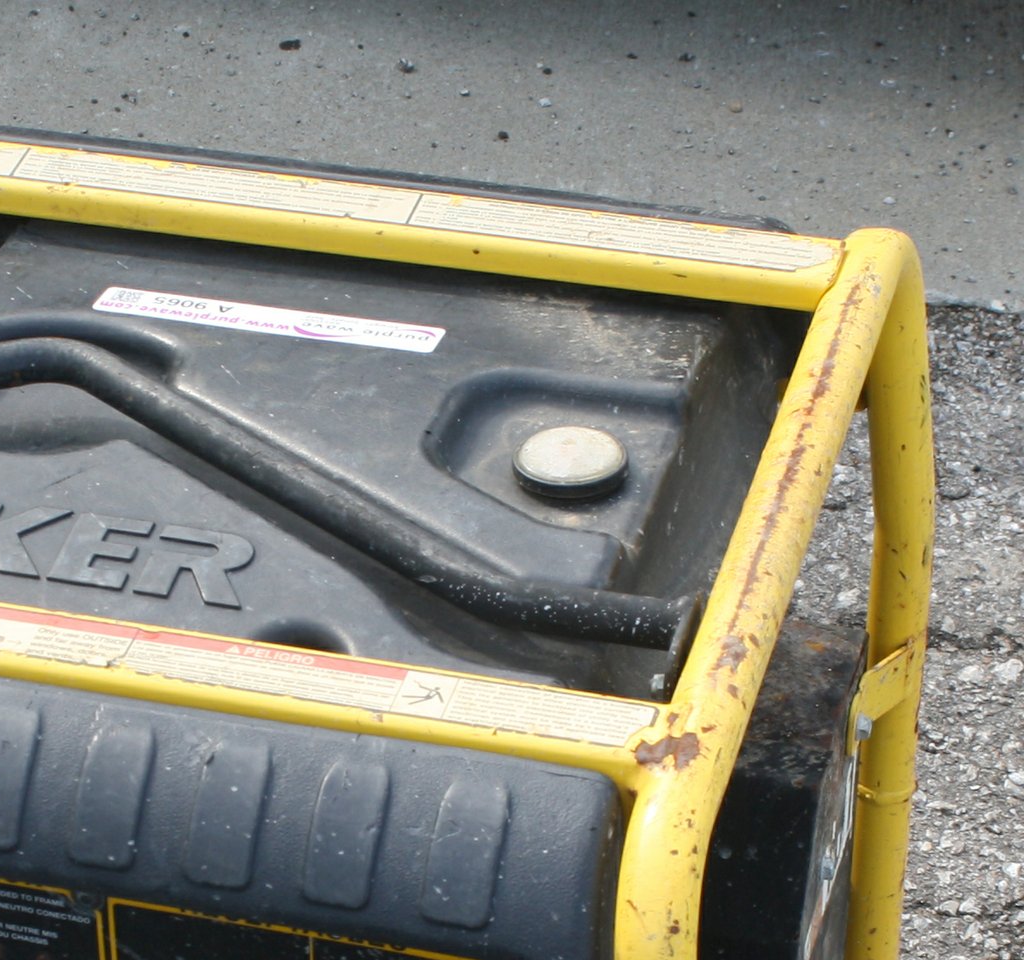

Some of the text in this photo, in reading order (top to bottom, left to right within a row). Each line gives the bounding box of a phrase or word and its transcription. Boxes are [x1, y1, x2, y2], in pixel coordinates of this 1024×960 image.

[154, 296, 233, 314] A 9065
[100, 300, 289, 330] www.purplewave.com
[302, 321, 431, 341] purple wave
[243, 646, 315, 666] PELIGRO
[34, 896, 66, 907] FRAME
[36, 908, 91, 924] CONECTADO
[5, 923, 40, 936] NEUTRE
[42, 930, 58, 938] MIS
[11, 933, 49, 945] CHASSIS
